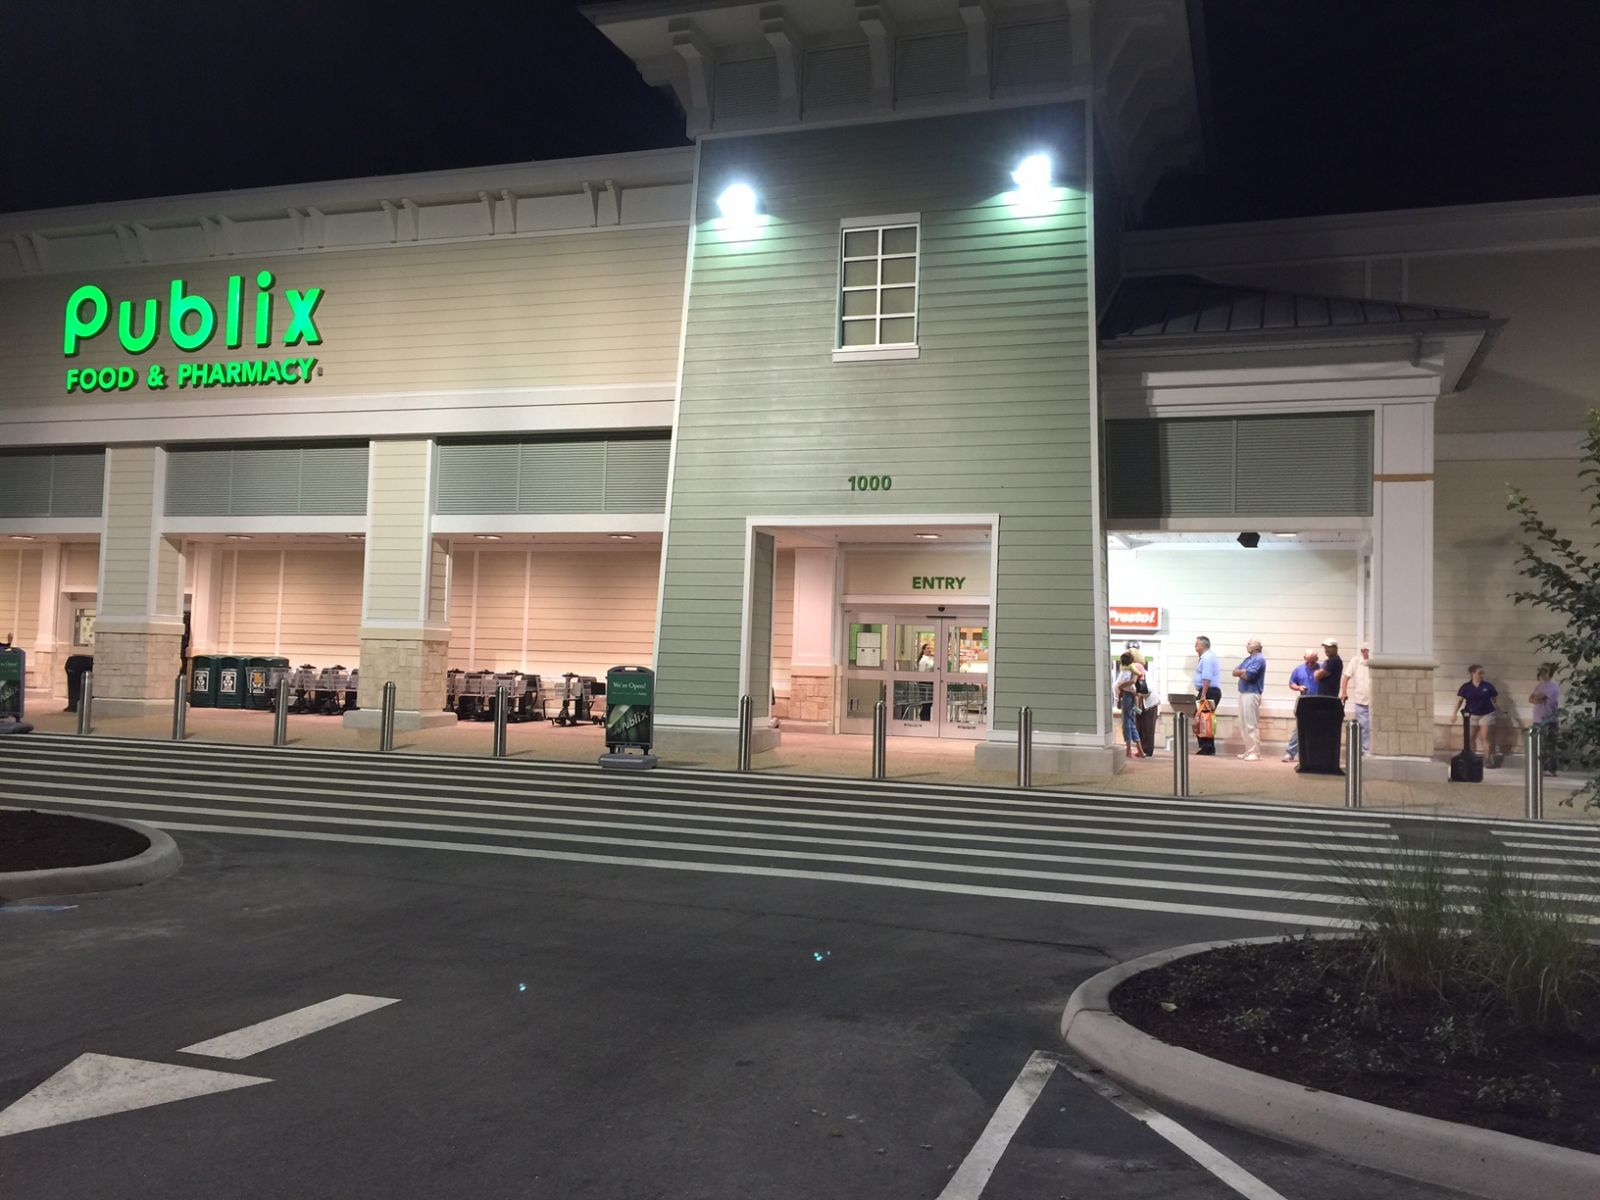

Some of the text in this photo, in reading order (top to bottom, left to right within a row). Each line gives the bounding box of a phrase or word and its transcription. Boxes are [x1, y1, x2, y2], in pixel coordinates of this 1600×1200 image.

[64, 270, 323, 356] Publix
[67, 357, 317, 392] FOOD & PHARMACY
[848, 475, 892, 491] 1000
[912, 576, 966, 589] ENTRY
